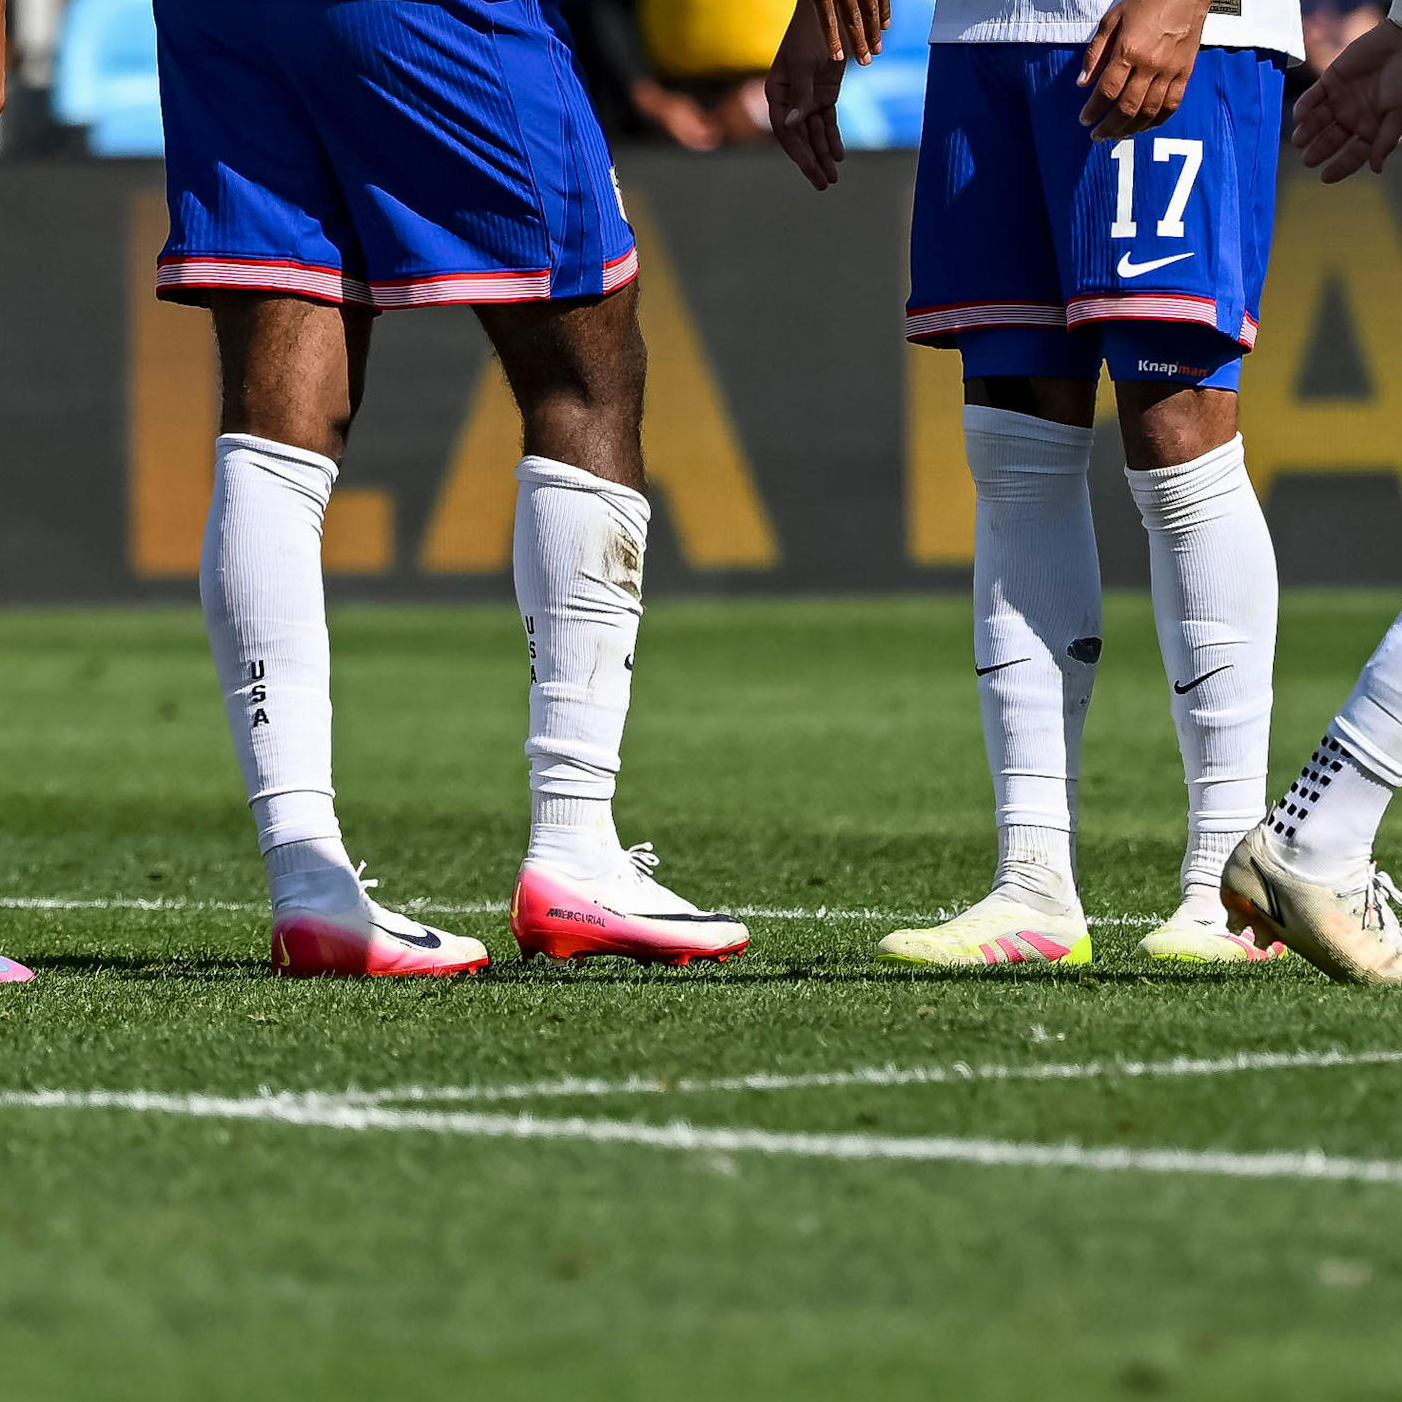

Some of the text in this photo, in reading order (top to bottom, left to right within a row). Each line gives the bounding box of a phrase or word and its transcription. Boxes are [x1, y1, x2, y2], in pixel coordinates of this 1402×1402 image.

[1110, 137, 1203, 238] 17
[525, 615, 538, 686] USA
[250, 659, 270, 728] USA
